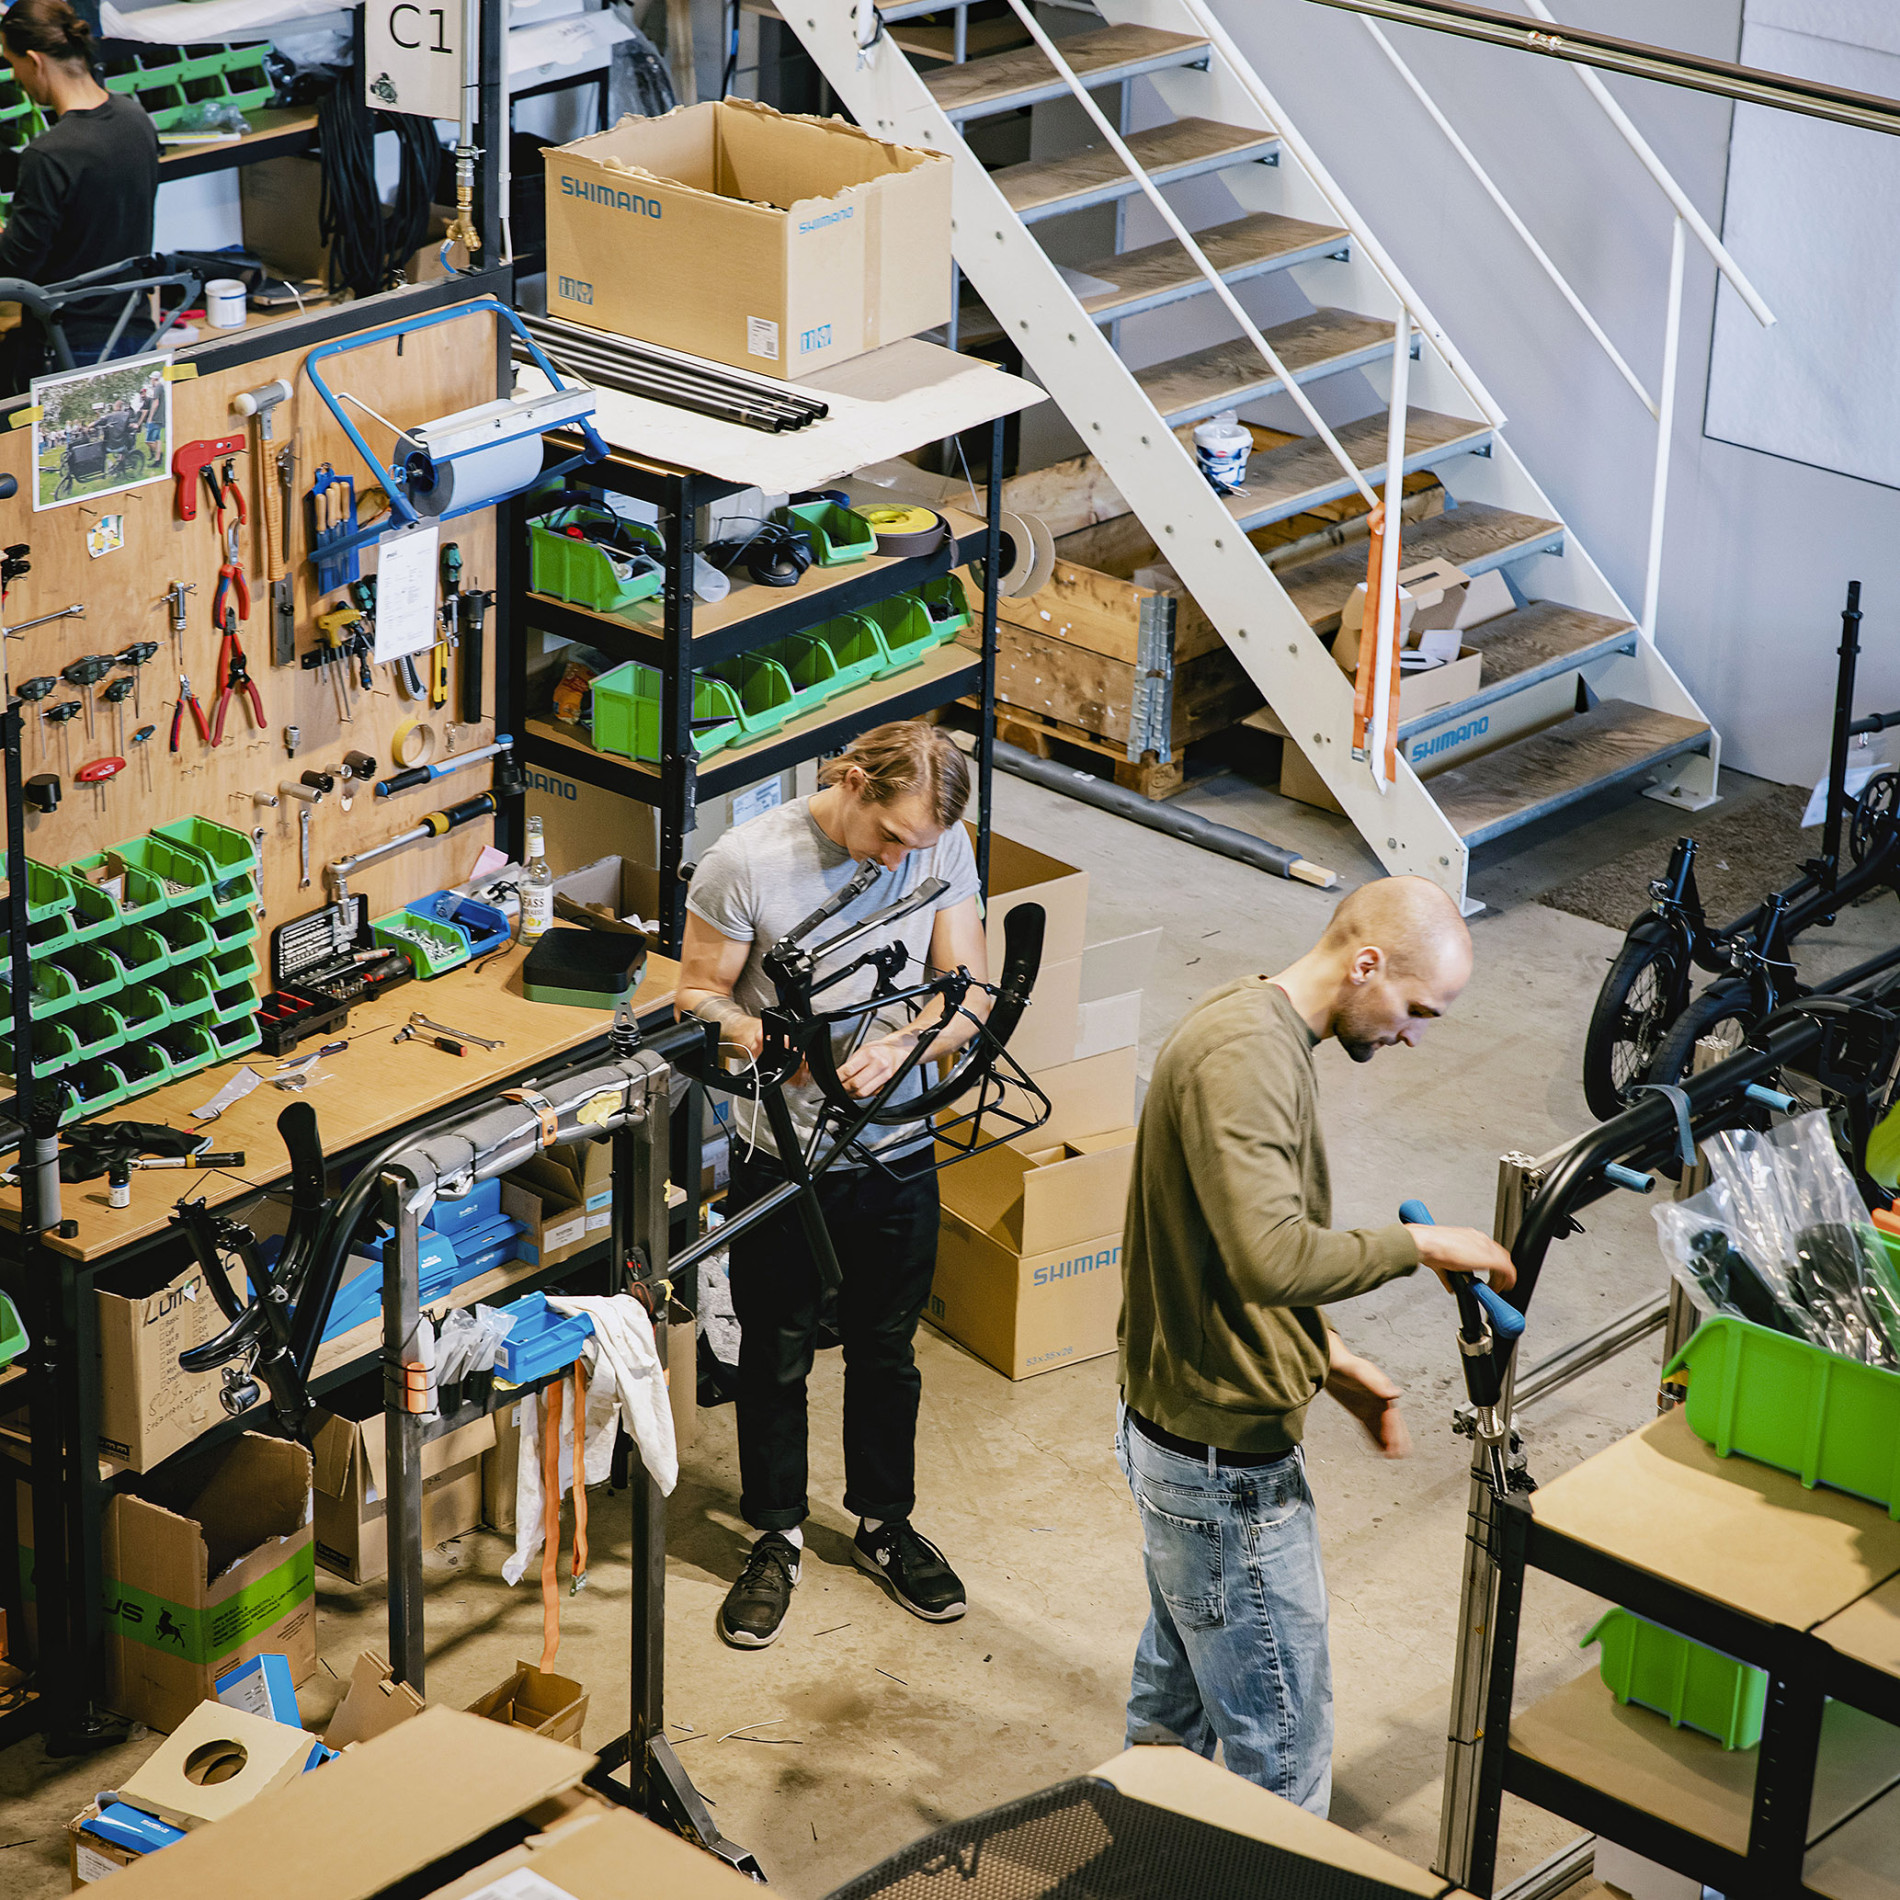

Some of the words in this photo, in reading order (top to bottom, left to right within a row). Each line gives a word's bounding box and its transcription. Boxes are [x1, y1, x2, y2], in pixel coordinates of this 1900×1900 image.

[389, 3, 453, 55] C1
[561, 175, 662, 219] SHIMANO
[798, 206, 854, 235] SHIMANO
[1411, 716, 1489, 763] SHIMANO
